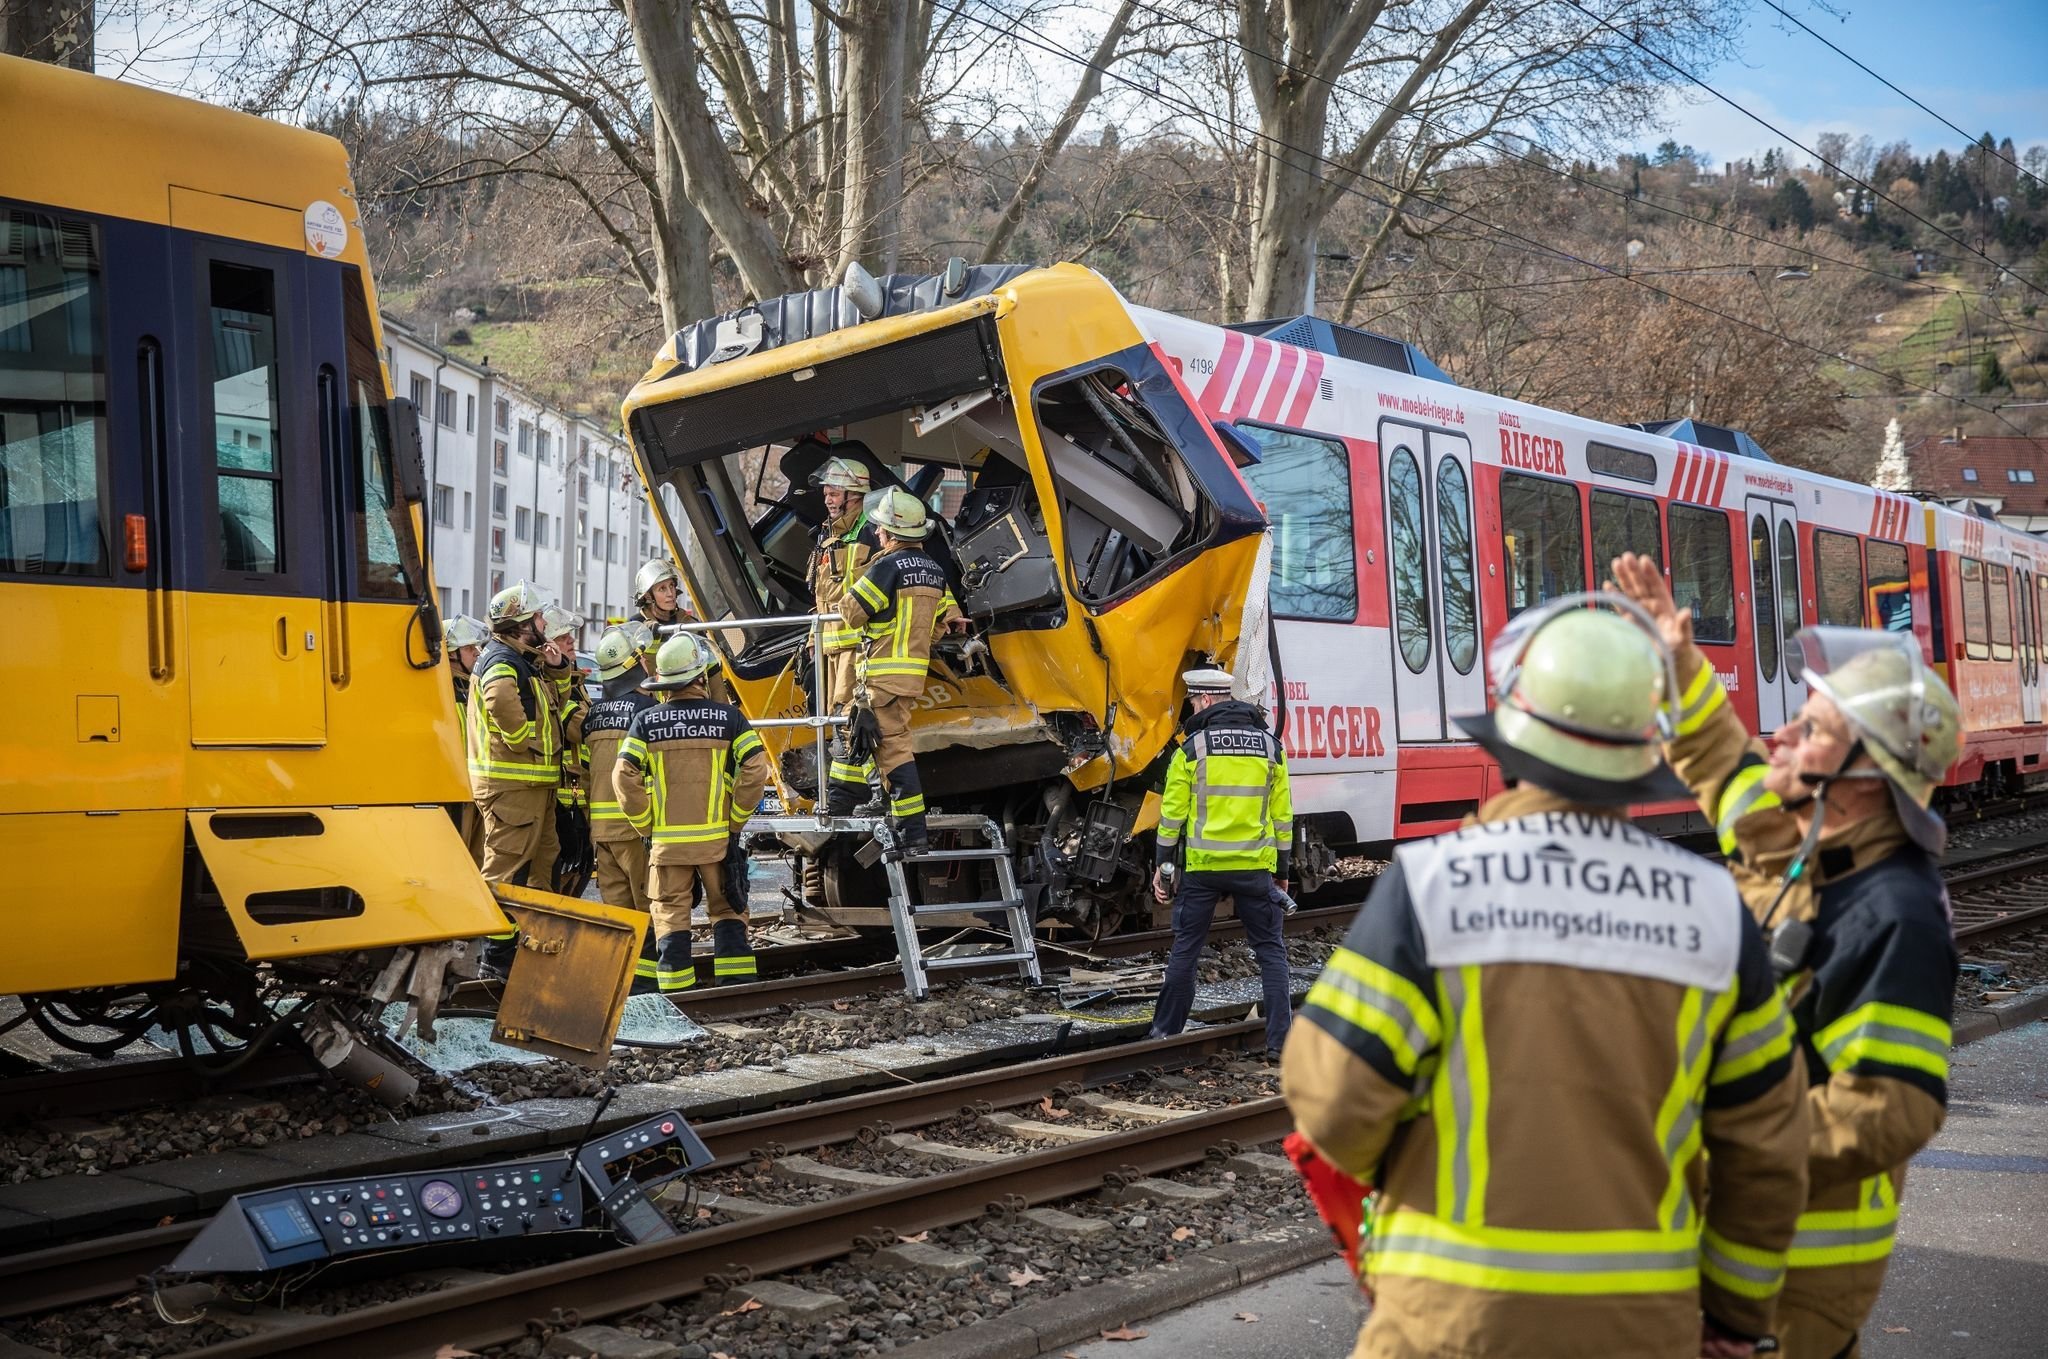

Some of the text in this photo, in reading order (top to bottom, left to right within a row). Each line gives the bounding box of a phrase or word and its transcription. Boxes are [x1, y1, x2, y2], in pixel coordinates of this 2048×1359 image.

[1190, 358, 1214, 375] 4198
[1377, 391, 1465, 426] www.moebel-rieger.de
[1498, 410, 1521, 428] MÖBEL
[1499, 428, 1567, 475] RIEGER
[895, 556, 944, 571] FEUERWE
[644, 708, 728, 725] FEUERWEHR
[648, 721, 725, 741] STUTTGART
[1272, 705, 1385, 758] RIEGER
[1211, 735, 1263, 749] POLIZEI
[1449, 841, 1695, 906] STUTTGART
[1450, 903, 1701, 952] Leitungsdienst 3
